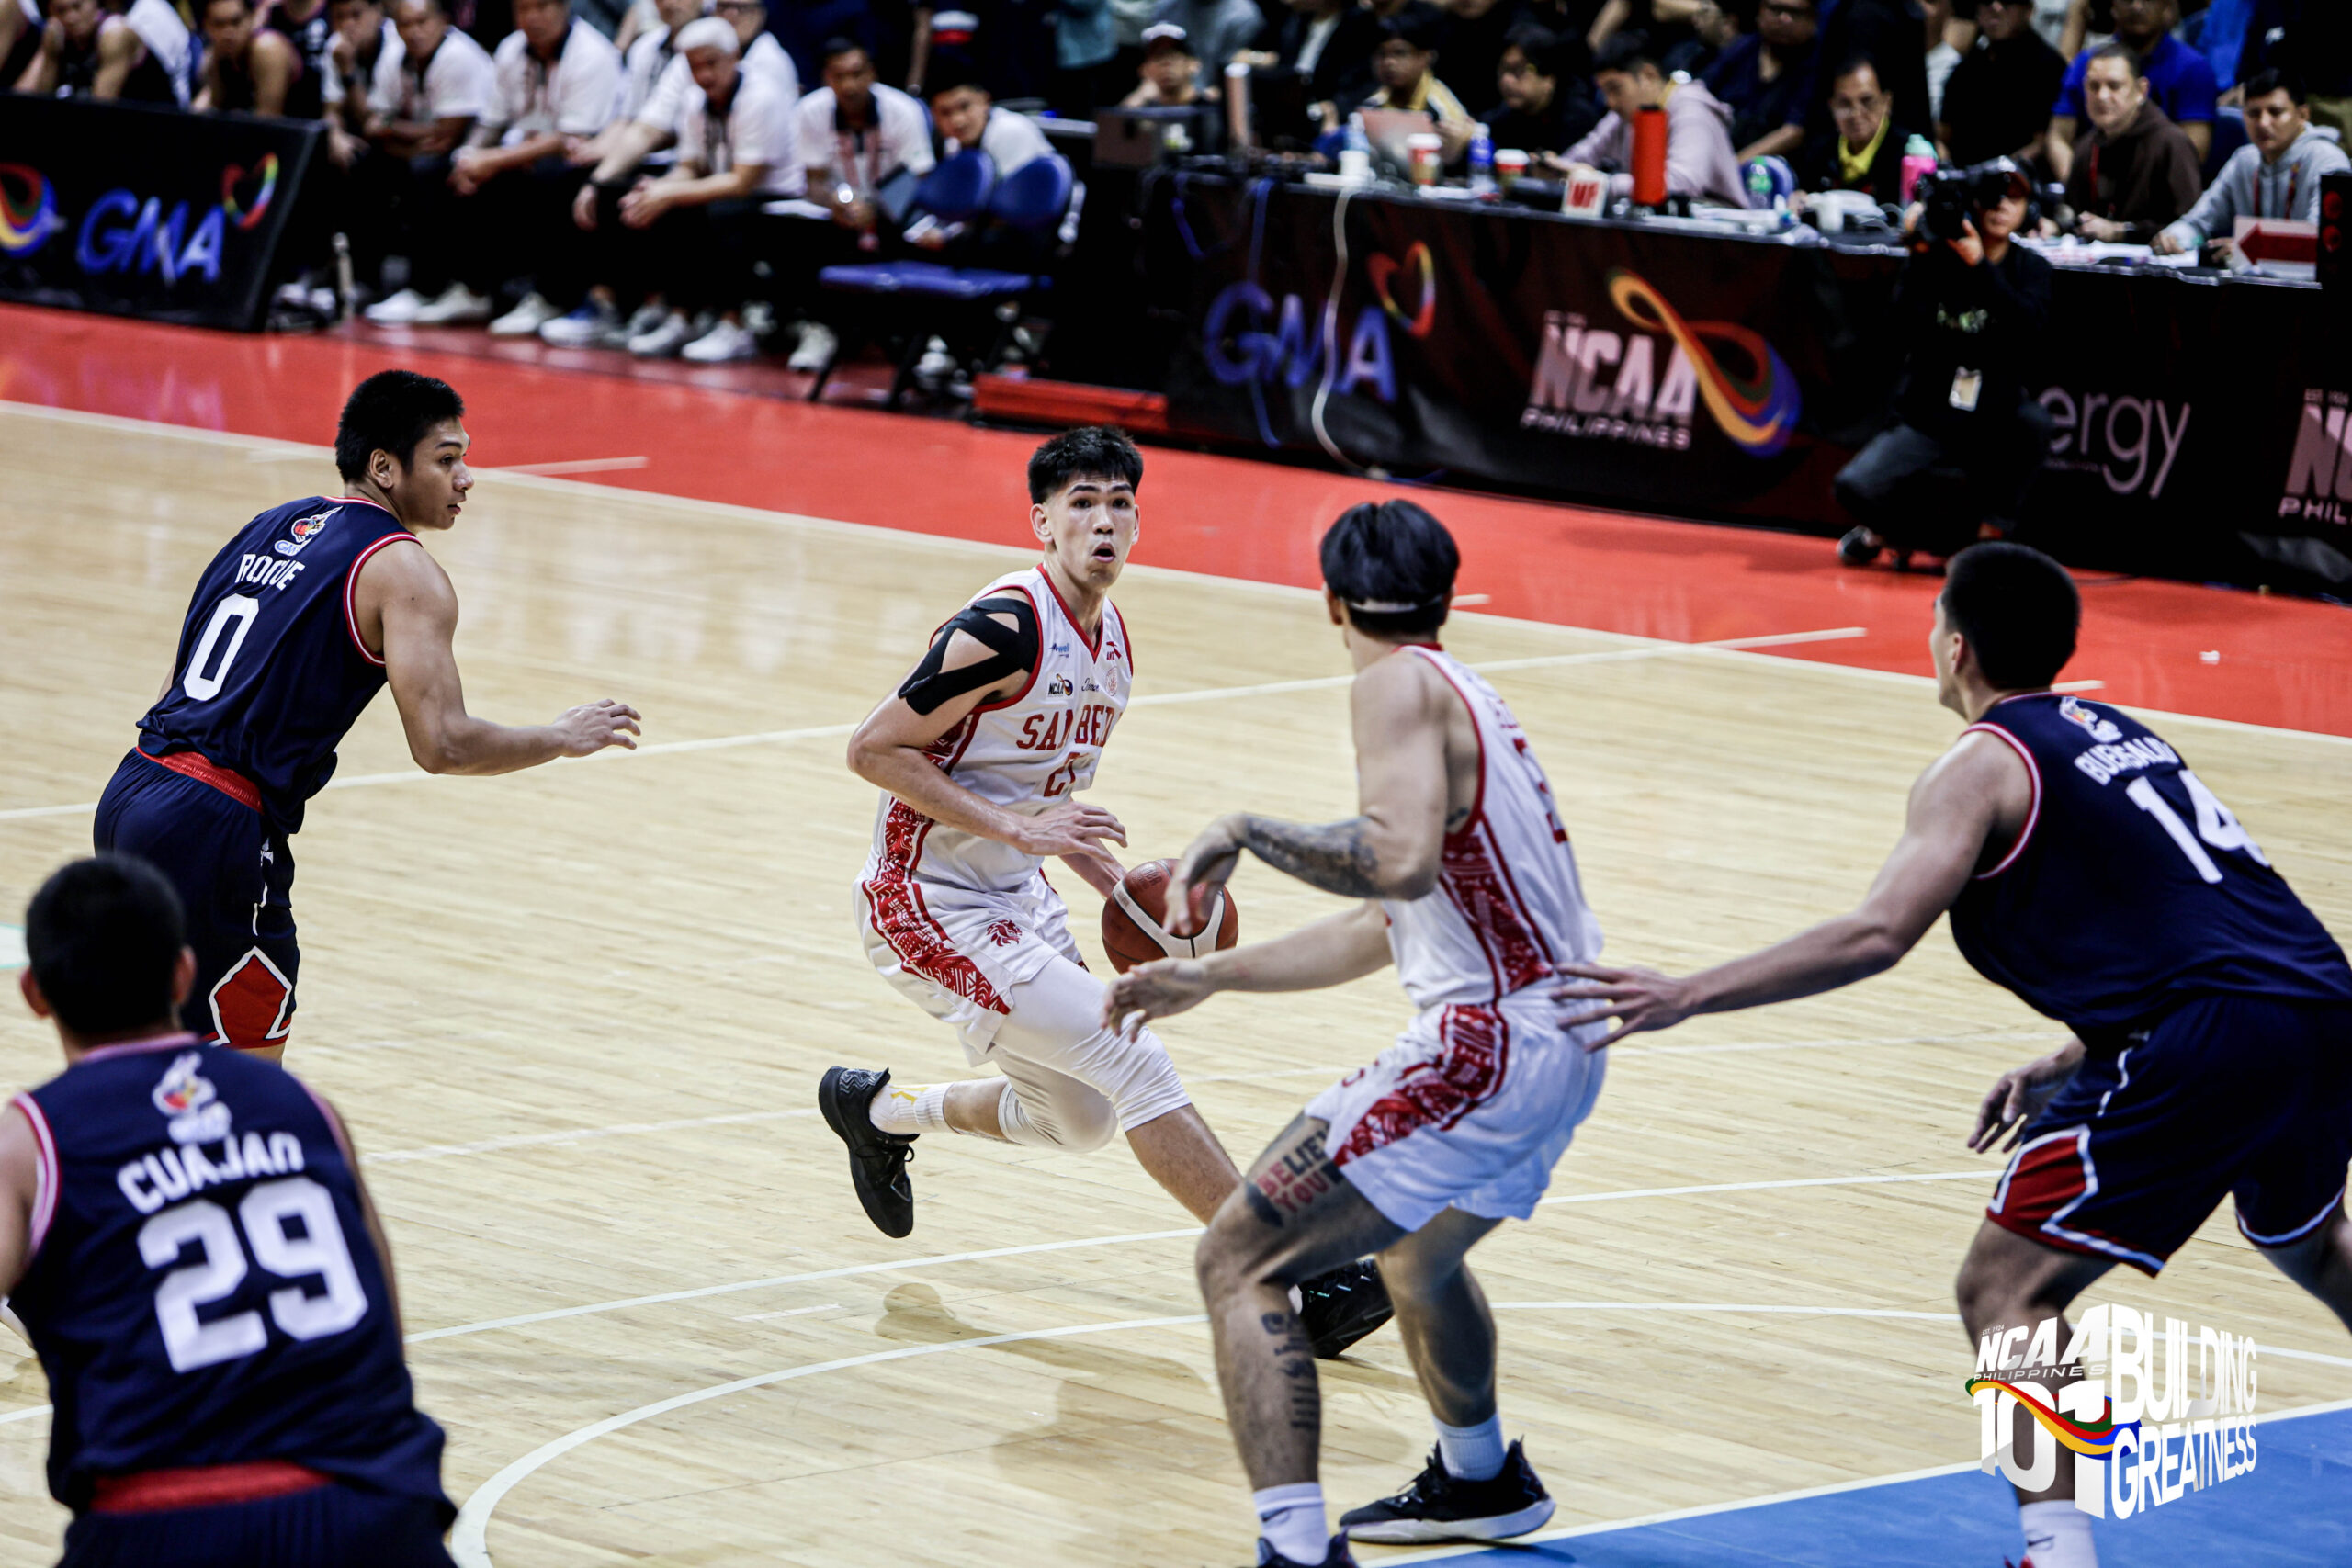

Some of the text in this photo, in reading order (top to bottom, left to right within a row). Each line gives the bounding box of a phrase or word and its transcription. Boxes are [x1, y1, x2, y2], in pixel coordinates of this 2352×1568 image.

[75, 188, 225, 284] GMA
[1203, 280, 1396, 402] GMA
[1530, 322, 1698, 426] NCAA
[1521, 406, 1690, 450] PHILIPPINES
[2285, 402, 2352, 501] N
[2278, 496, 2352, 525] PHIL
[183, 592, 260, 702] 0
[1074, 704, 1123, 748] BED
[2125, 768, 2272, 885] 14
[137, 1175, 369, 1374] 29
